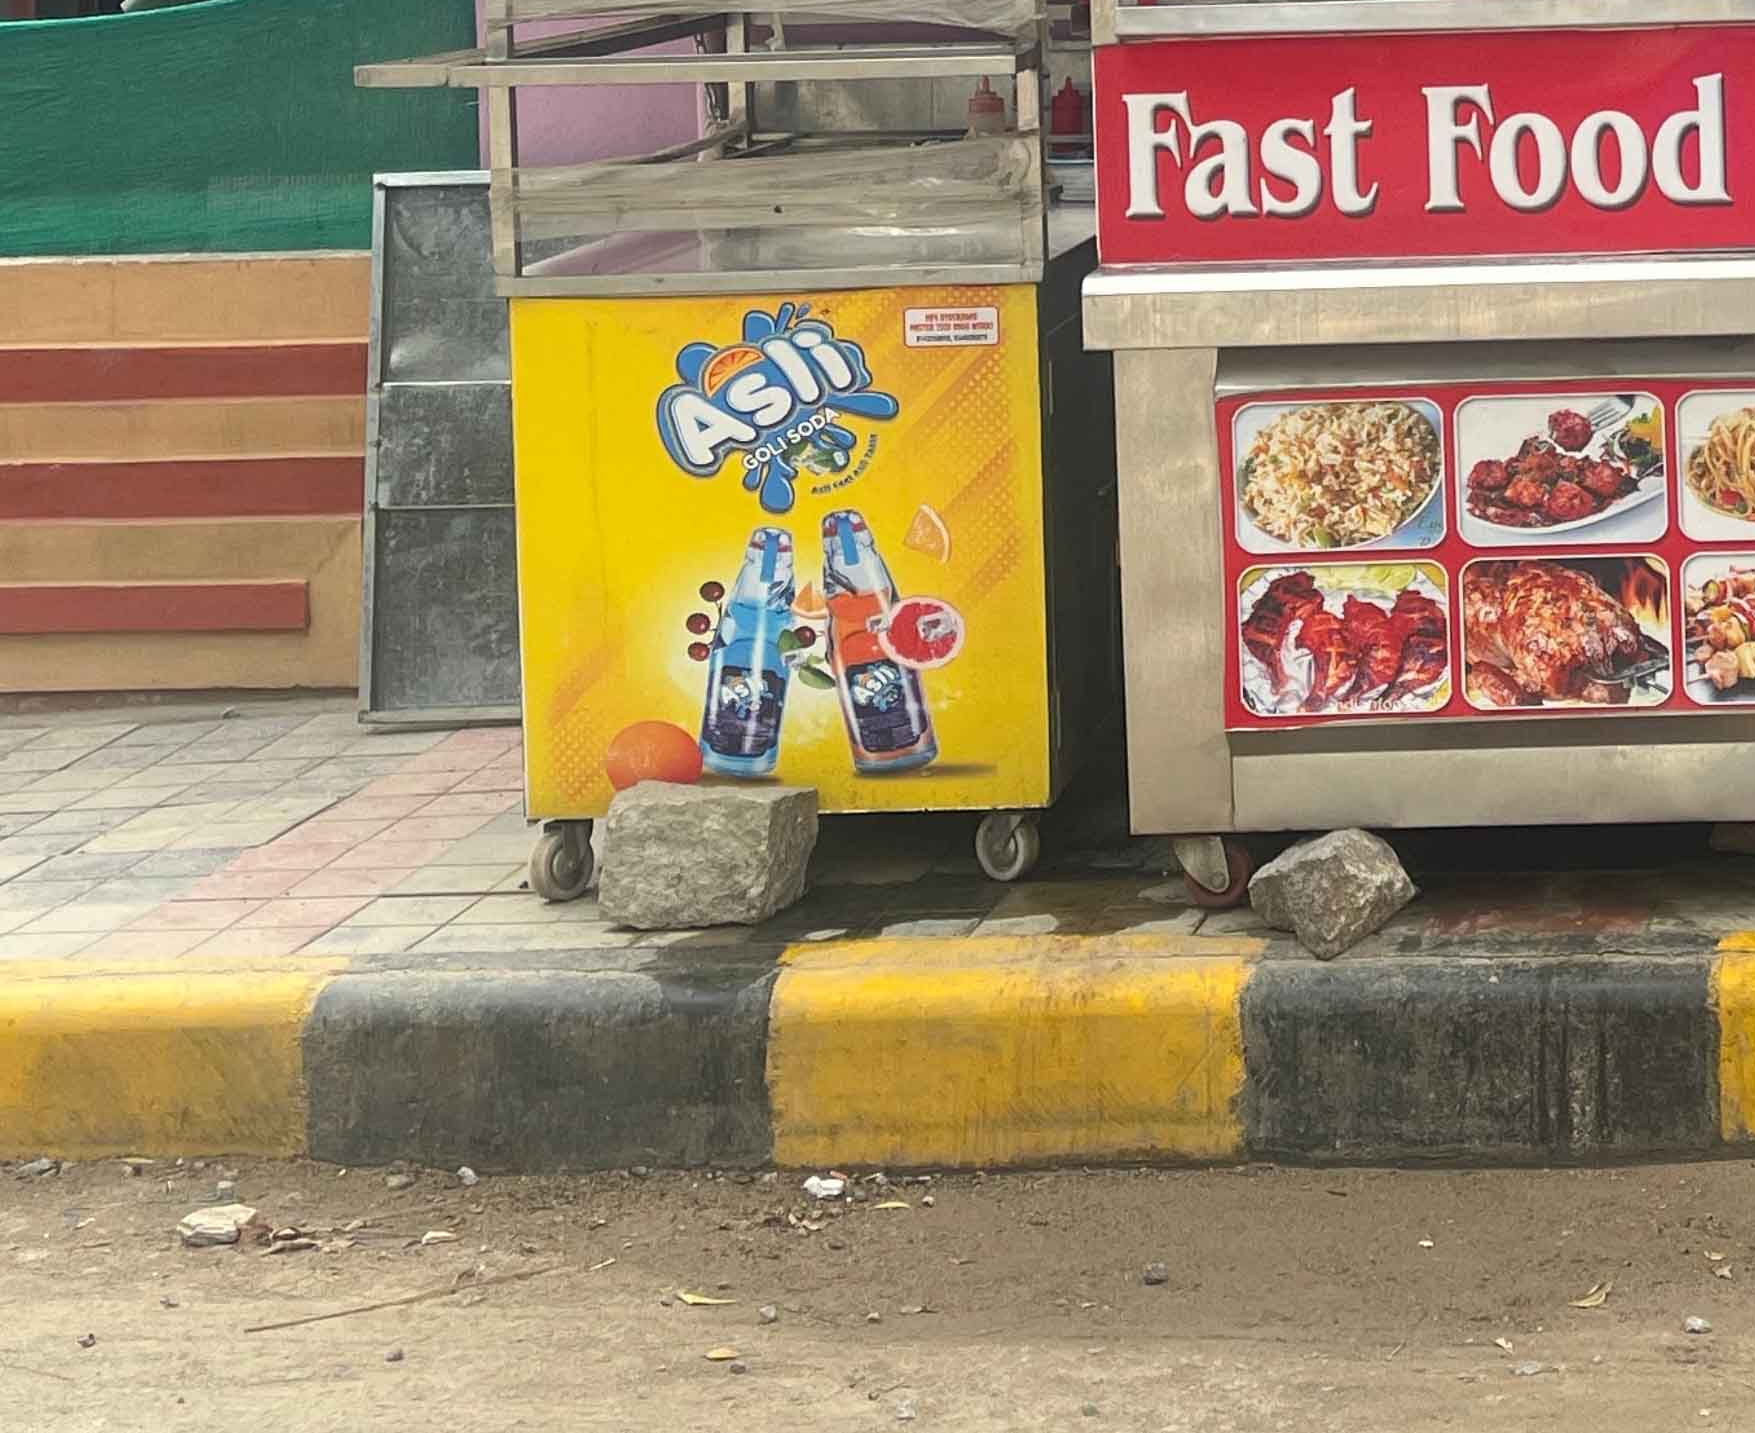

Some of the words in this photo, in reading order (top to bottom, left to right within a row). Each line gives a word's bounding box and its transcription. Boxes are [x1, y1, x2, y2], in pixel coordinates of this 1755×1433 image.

[1121, 86, 1381, 219] Fast
[1421, 73, 1735, 213] Food
[742, 436, 788, 471] GOLI
[788, 407, 842, 444] SODA
